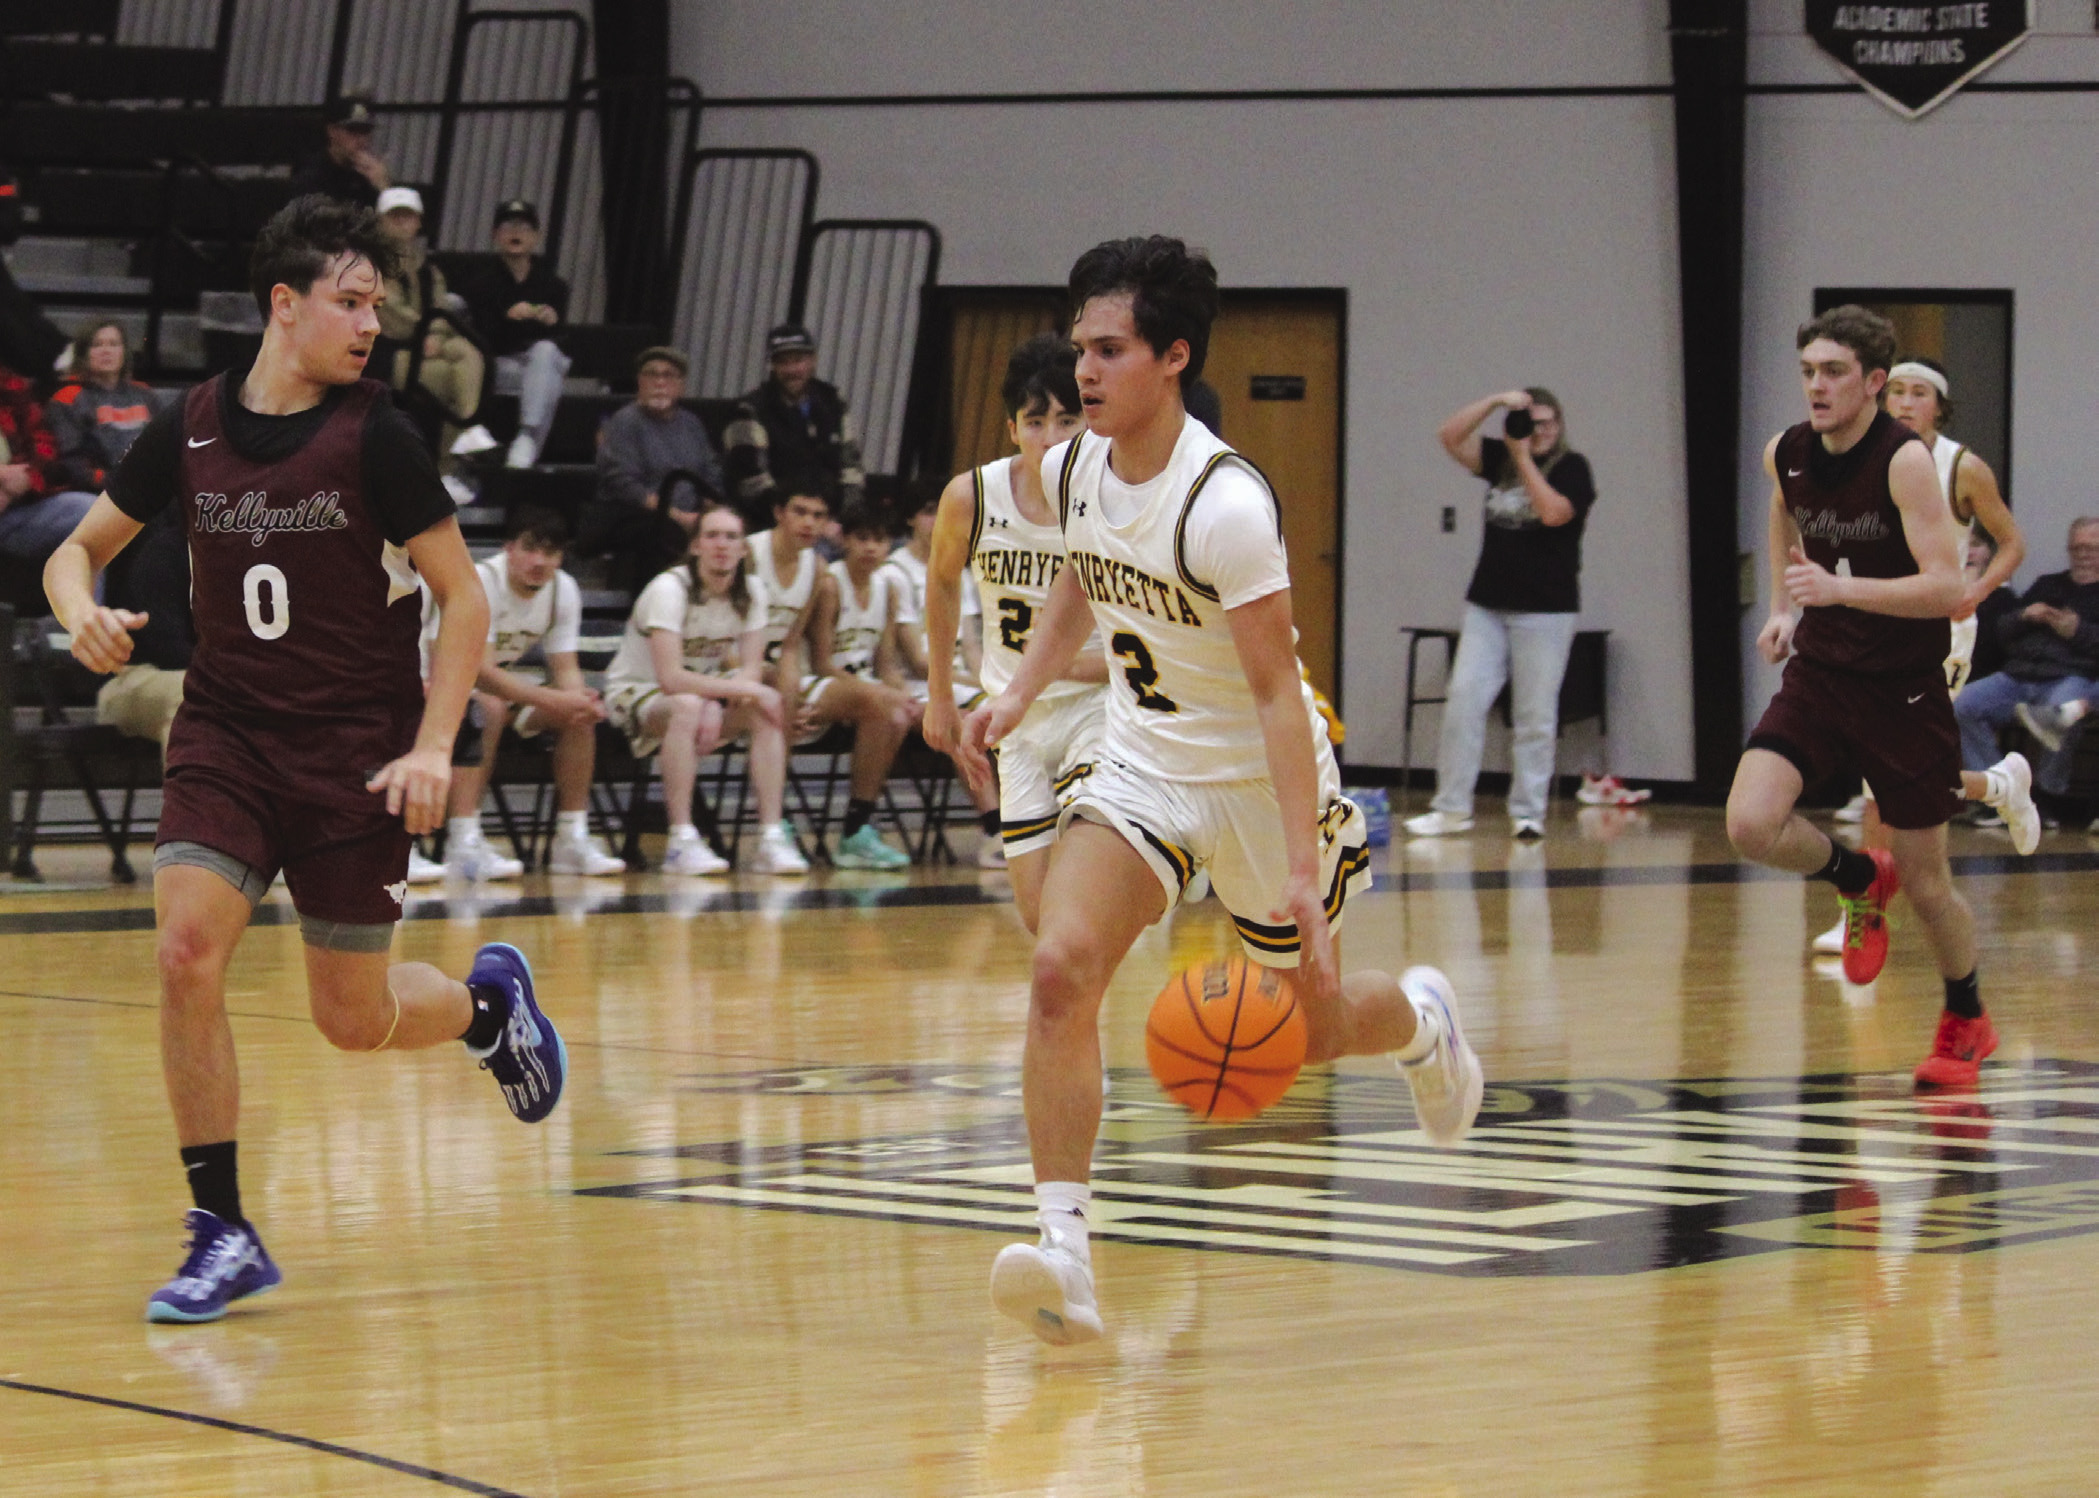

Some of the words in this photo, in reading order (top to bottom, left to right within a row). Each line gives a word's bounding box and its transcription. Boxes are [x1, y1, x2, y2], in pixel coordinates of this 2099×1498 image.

[1832, 5, 1933, 33] ACADEMIC
[1935, 2, 1990, 31] STATE
[1853, 38, 1966, 66] CHAMPIONS
[195, 491, 348, 547] Kellyville
[242, 563, 290, 641] 0
[1111, 630, 1180, 713] 2
